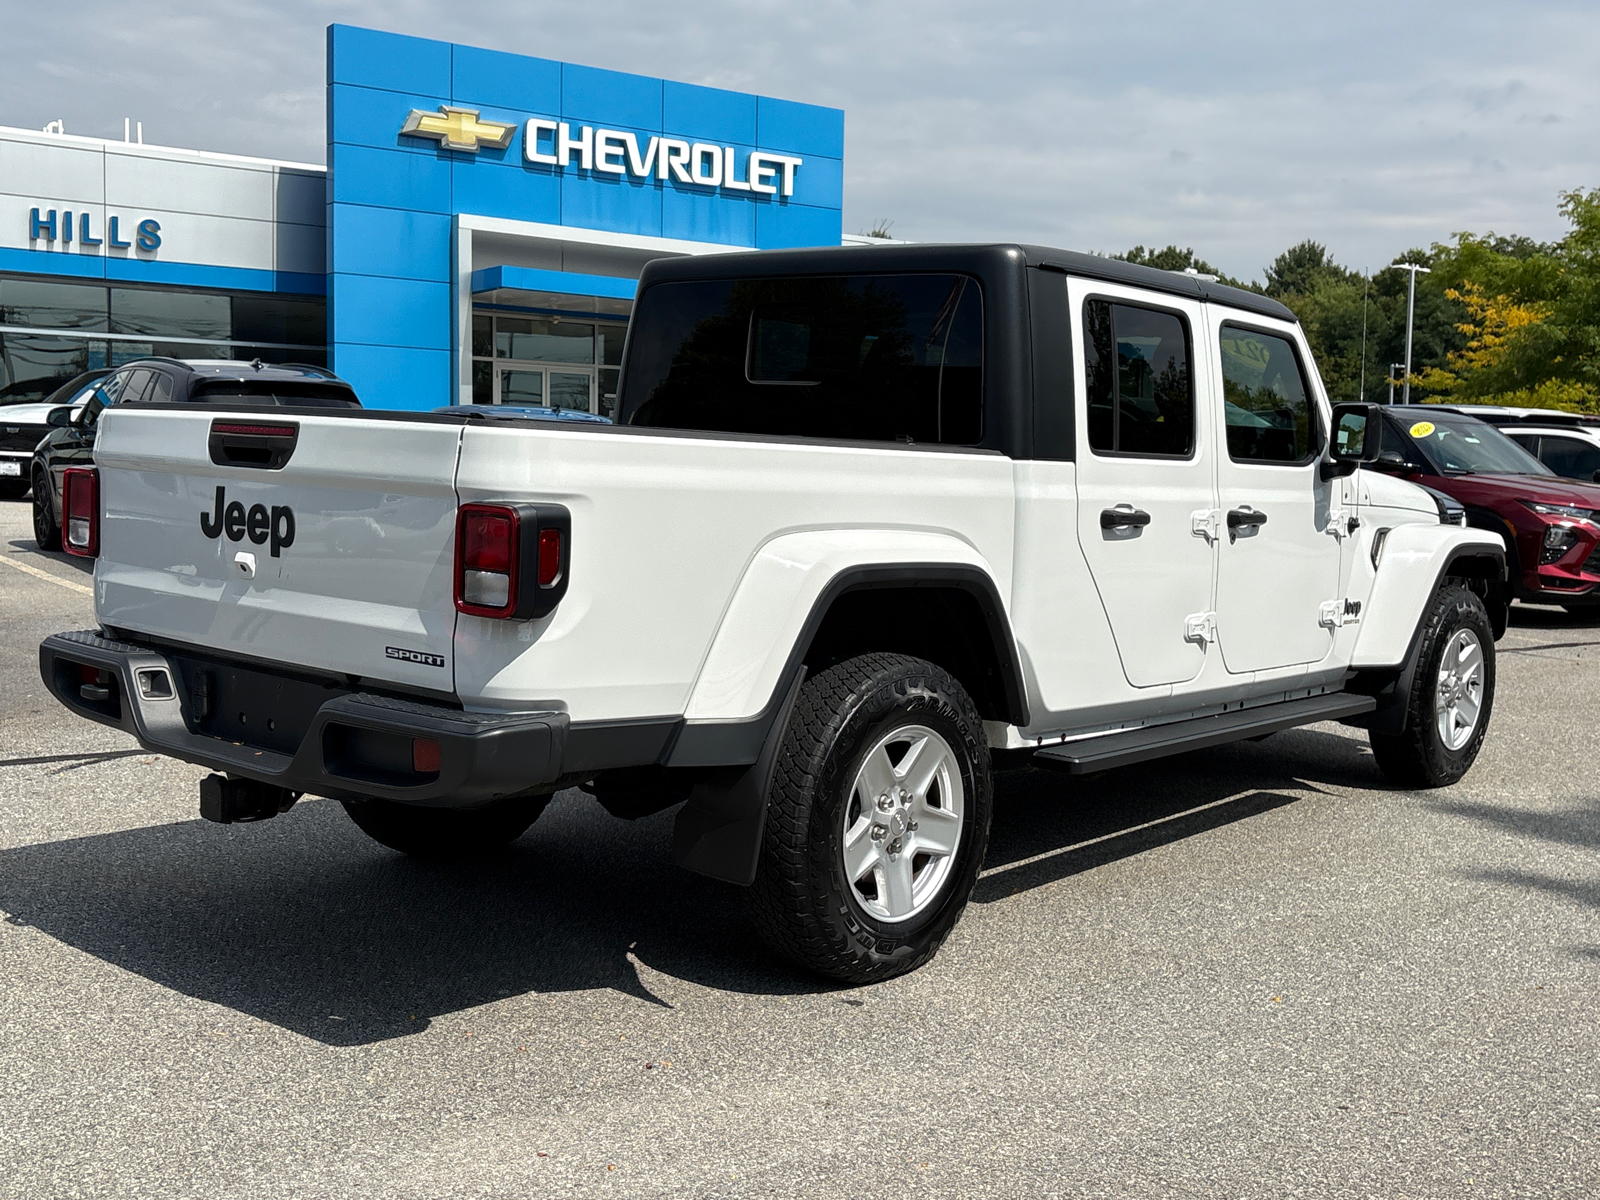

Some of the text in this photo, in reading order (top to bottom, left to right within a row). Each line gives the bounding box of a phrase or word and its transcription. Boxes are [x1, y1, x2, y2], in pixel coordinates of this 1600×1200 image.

[524, 118, 803, 198] CHEVROLET
[30, 206, 162, 252] HILLS
[200, 485, 296, 558] Jeep
[1343, 597, 1362, 618] Jeep
[386, 646, 445, 667] SPORT
